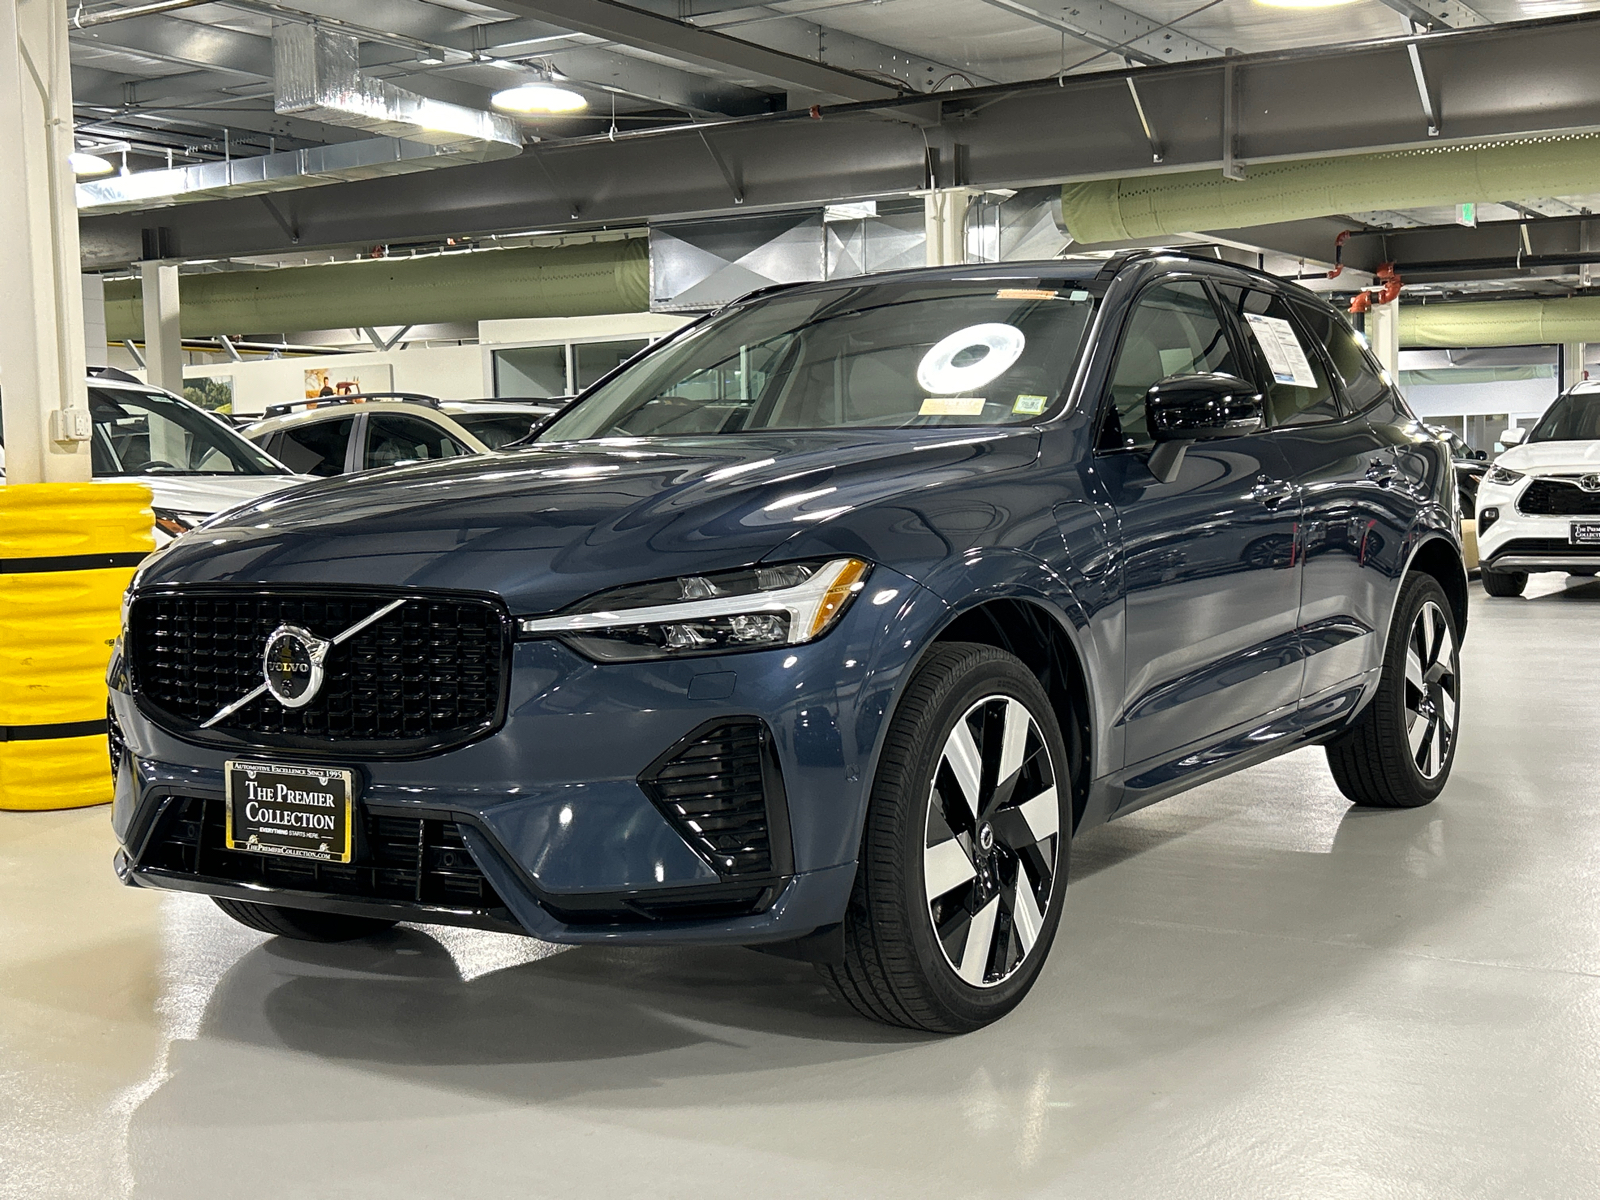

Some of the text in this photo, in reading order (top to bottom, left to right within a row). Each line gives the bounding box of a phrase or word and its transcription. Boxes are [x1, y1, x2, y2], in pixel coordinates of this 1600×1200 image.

[267, 661, 309, 673] VOLVO
[235, 763, 342, 778] AUTOMOTIVE EXCELLENCE SINCE 1995
[245, 781, 335, 807] THE PREMIER
[245, 801, 335, 830] COLLECTION
[259, 827, 288, 835] EVERYTHING
[289, 830, 306, 838] STARTS
